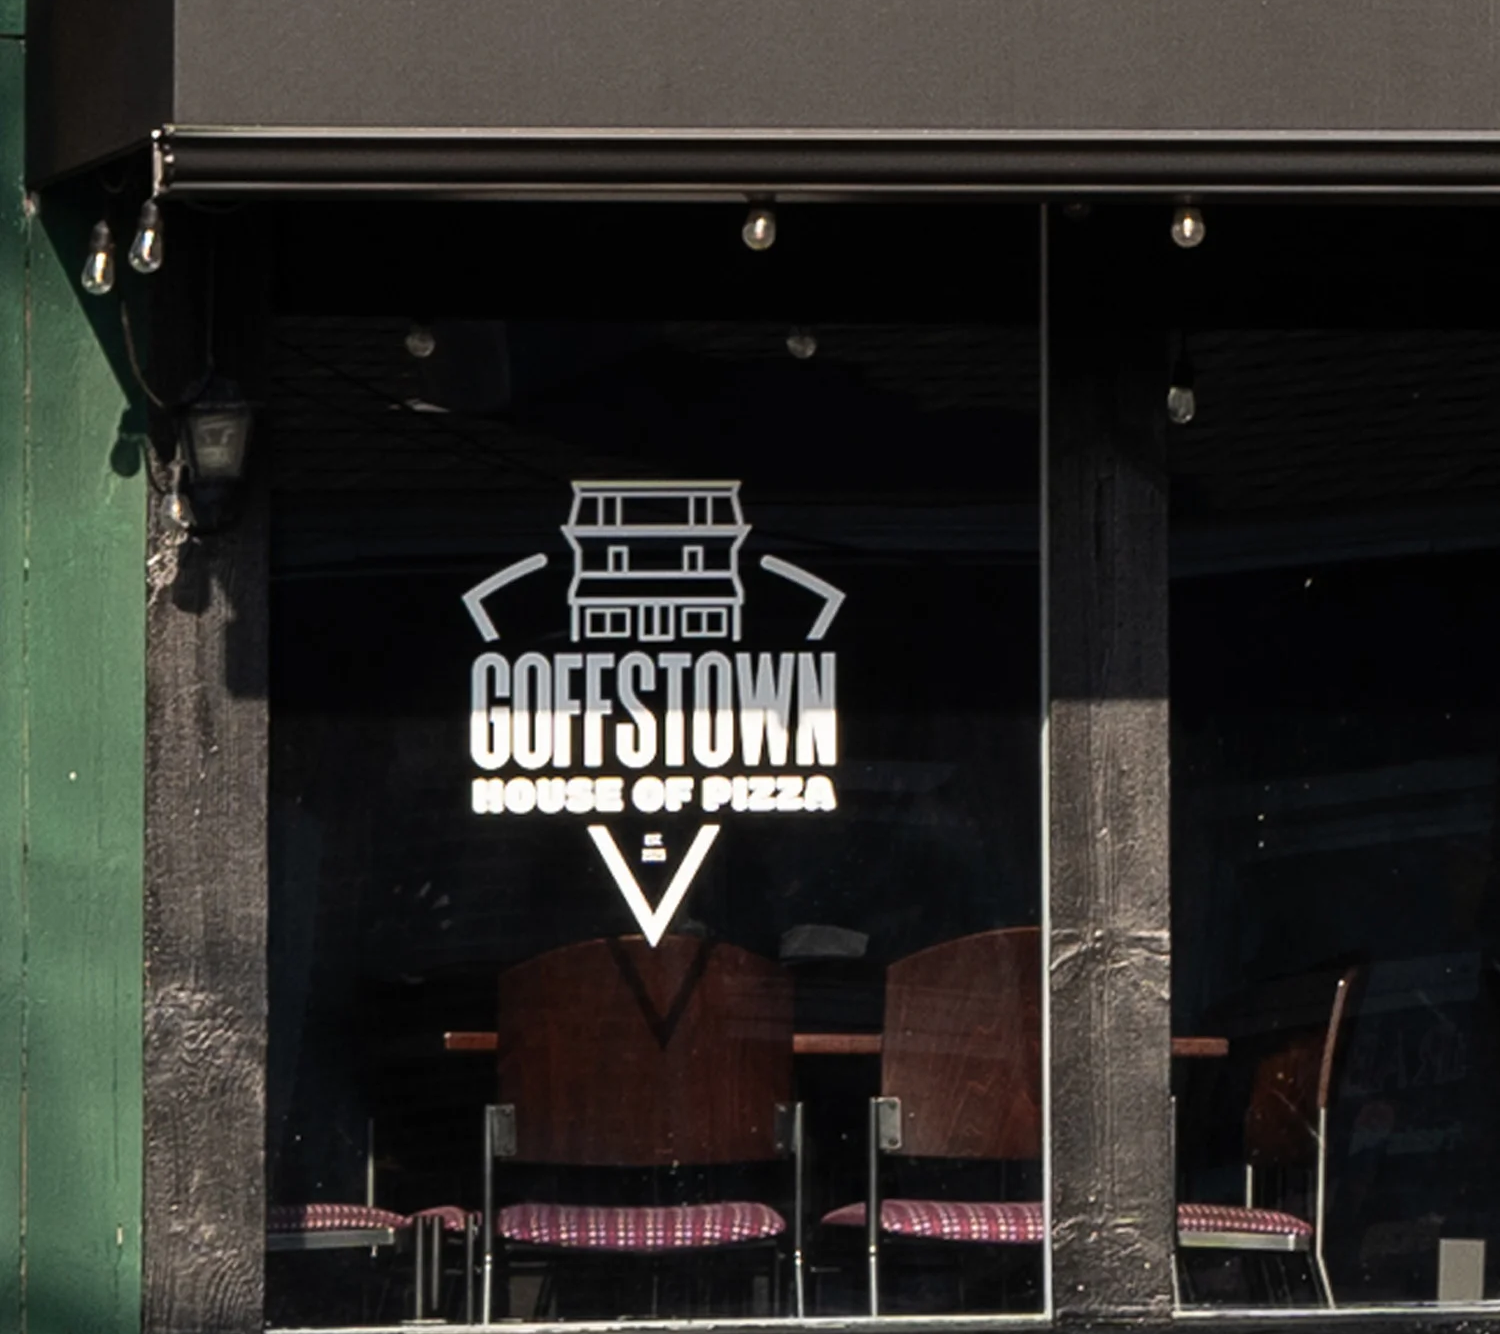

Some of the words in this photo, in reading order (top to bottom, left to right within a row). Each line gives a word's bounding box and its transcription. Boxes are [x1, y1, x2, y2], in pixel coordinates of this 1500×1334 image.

[469, 650, 839, 770] GOFFSTOWN
[470, 775, 626, 815] HOUSE
[631, 775, 695, 814] OF
[701, 775, 839, 814] PIZZA
